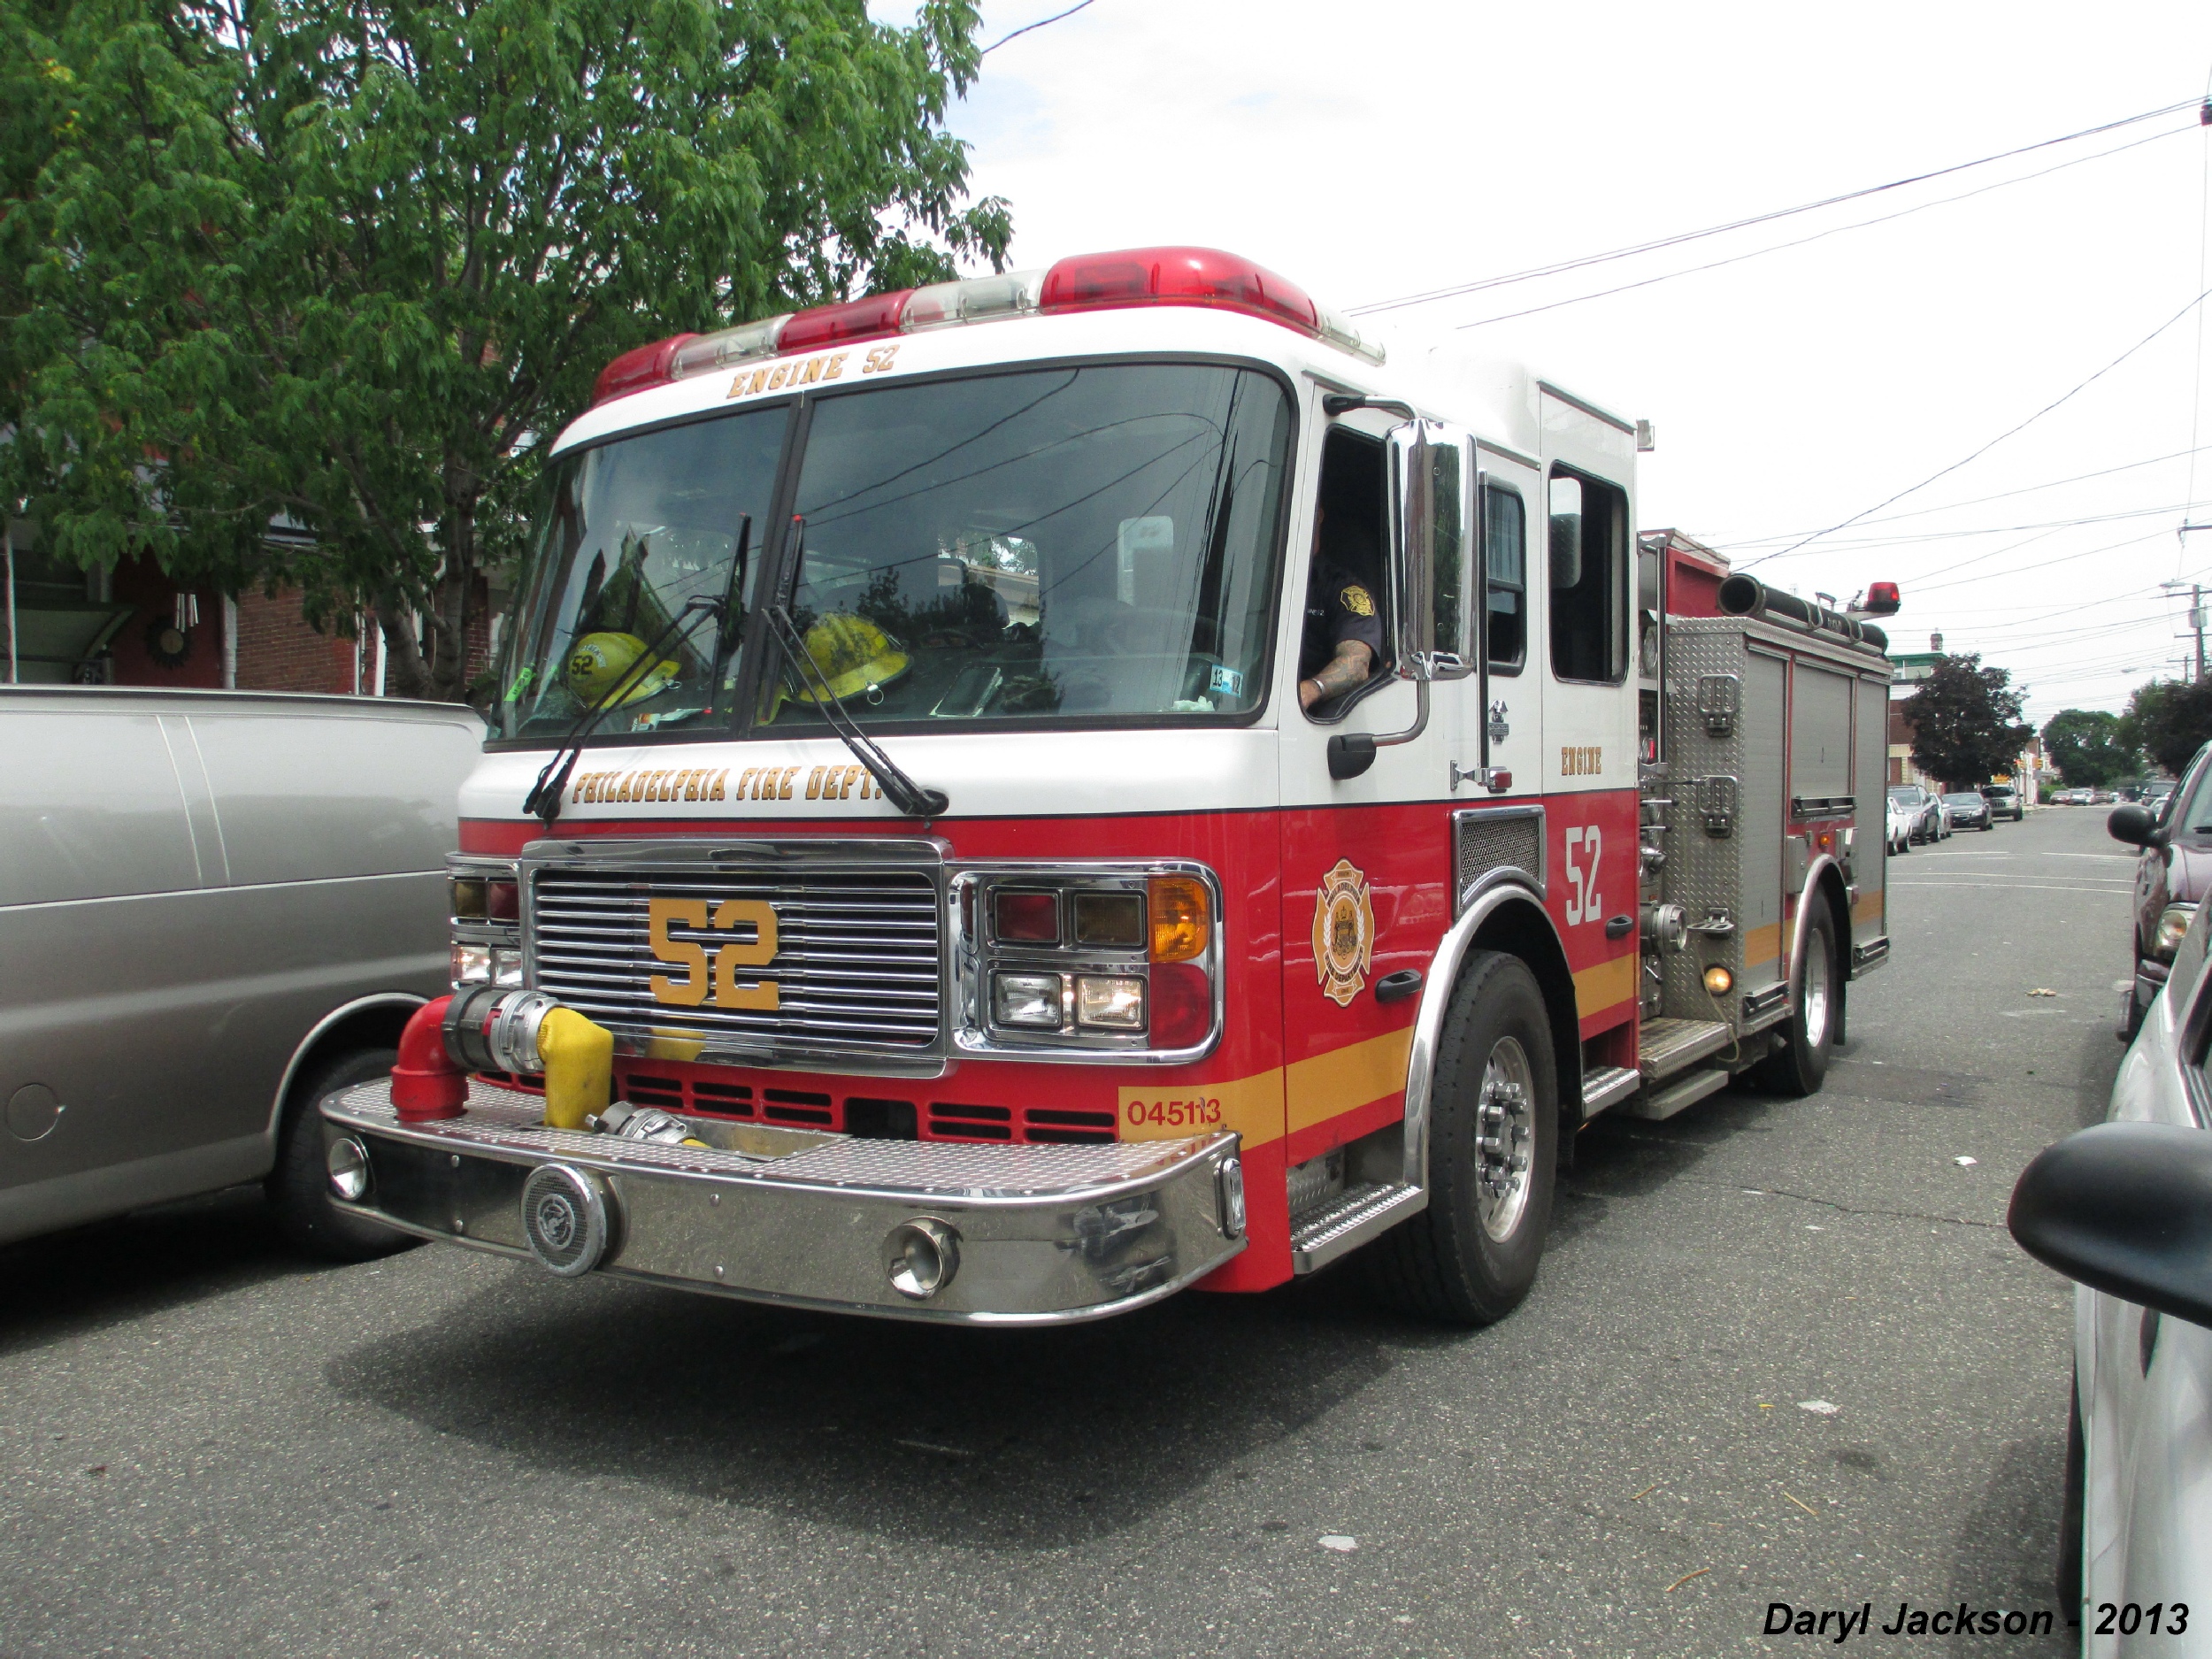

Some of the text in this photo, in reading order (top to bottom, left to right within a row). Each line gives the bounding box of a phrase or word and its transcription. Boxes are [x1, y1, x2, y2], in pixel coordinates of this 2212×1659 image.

[726, 344, 901, 399] ENGINE 52
[572, 655, 594, 675] 52
[1561, 746, 1602, 776] ENGINE
[572, 768, 731, 803] PHILADELPHIA
[736, 765, 803, 802] FIRE
[1565, 825, 1601, 927] 52
[649, 898, 780, 1011] 52
[1127, 1098, 1221, 1126] 045113
